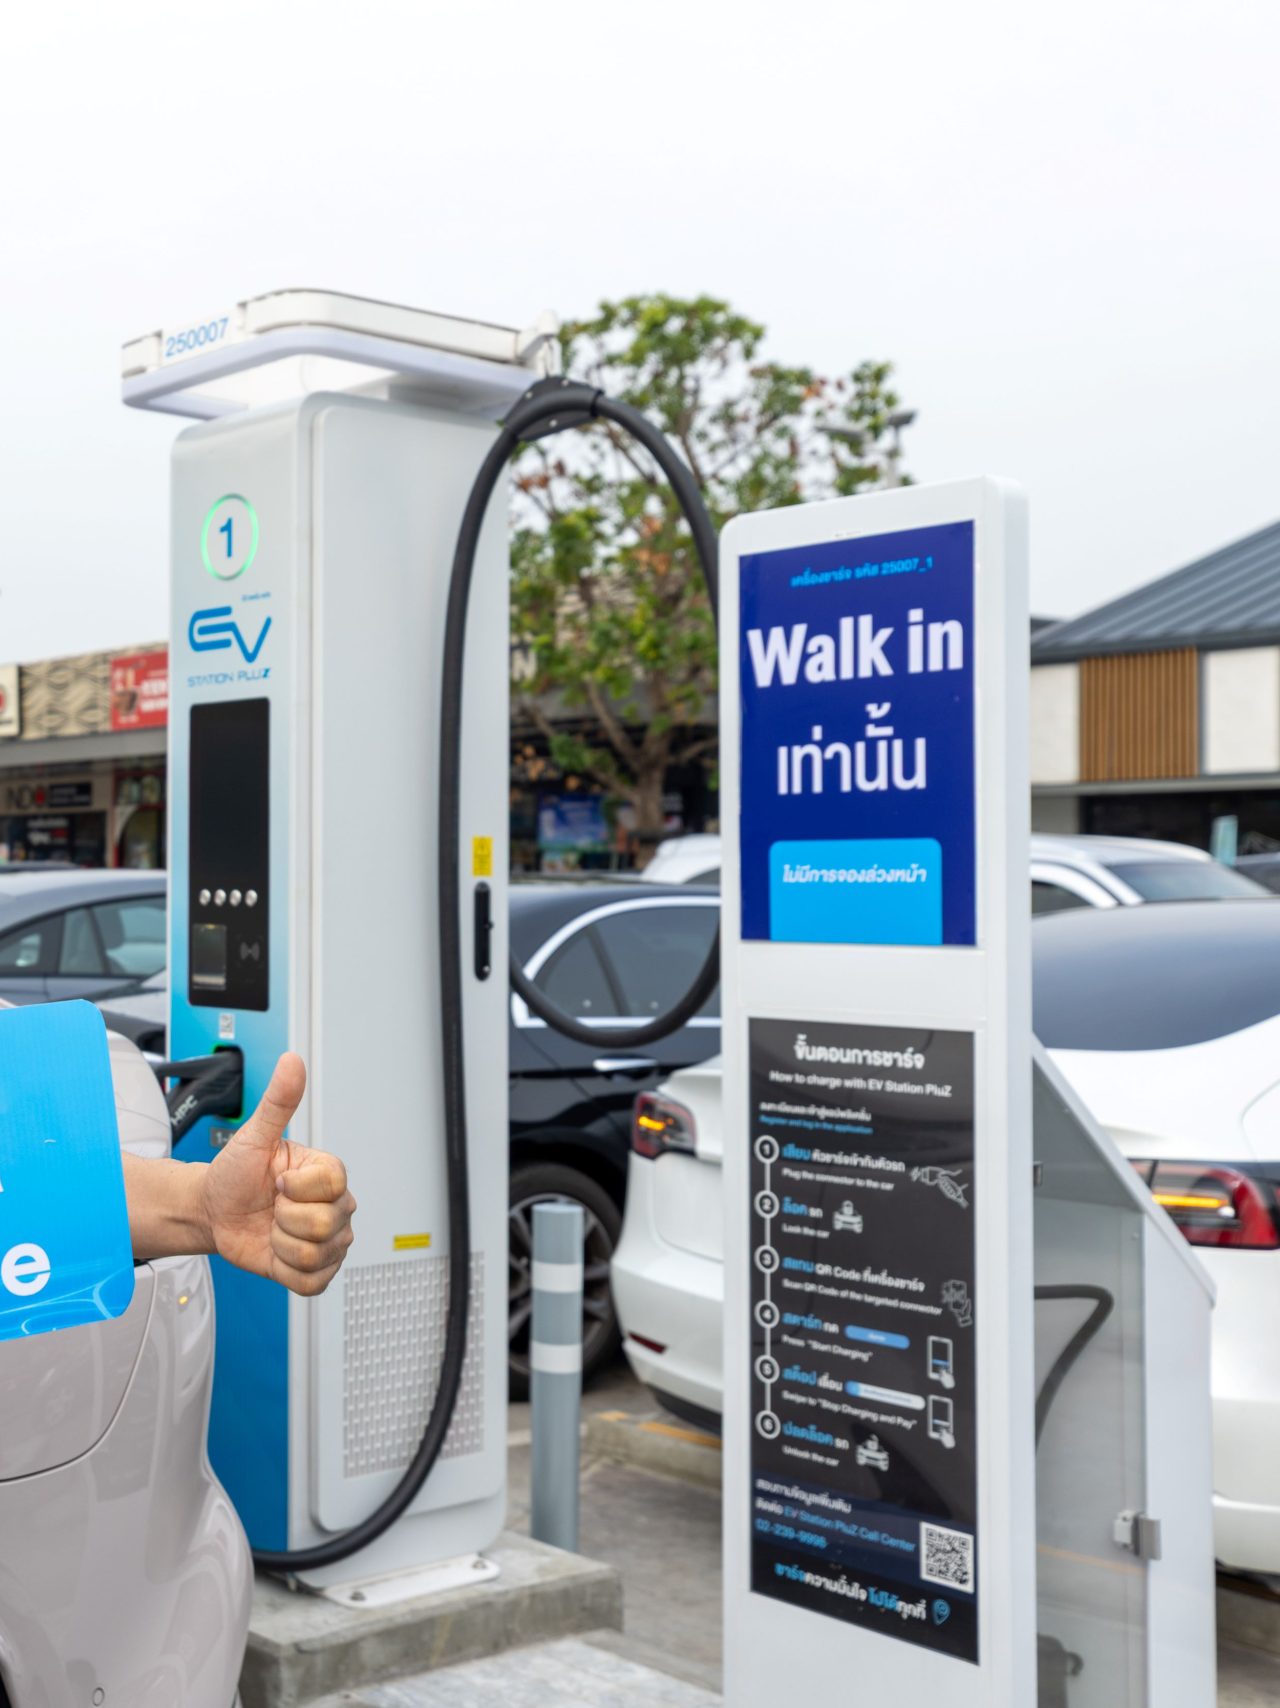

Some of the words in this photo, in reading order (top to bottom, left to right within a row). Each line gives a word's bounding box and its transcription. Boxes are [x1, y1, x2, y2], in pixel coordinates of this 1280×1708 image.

[165, 317, 229, 357] 250007
[219, 517, 233, 558] 1
[188, 606, 272, 663] EV
[747, 613, 894, 688] Walk
[908, 608, 963, 674] in
[187, 672, 233, 688] STATION
[777, 702, 926, 795] เท่านั้น
[783, 864, 927, 883] ไม่มีการจองล่วงหน้า
[794, 1034, 925, 1069] ขั้นตอนการชาร์จ
[769, 1071, 793, 1082] How
[795, 1072, 806, 1083] to
[807, 1074, 842, 1088] charge
[844, 1077, 866, 1089] with
[868, 1079, 884, 1091] EV
[885, 1080, 924, 1094] Station
[880, 1533, 915, 1552] Center
